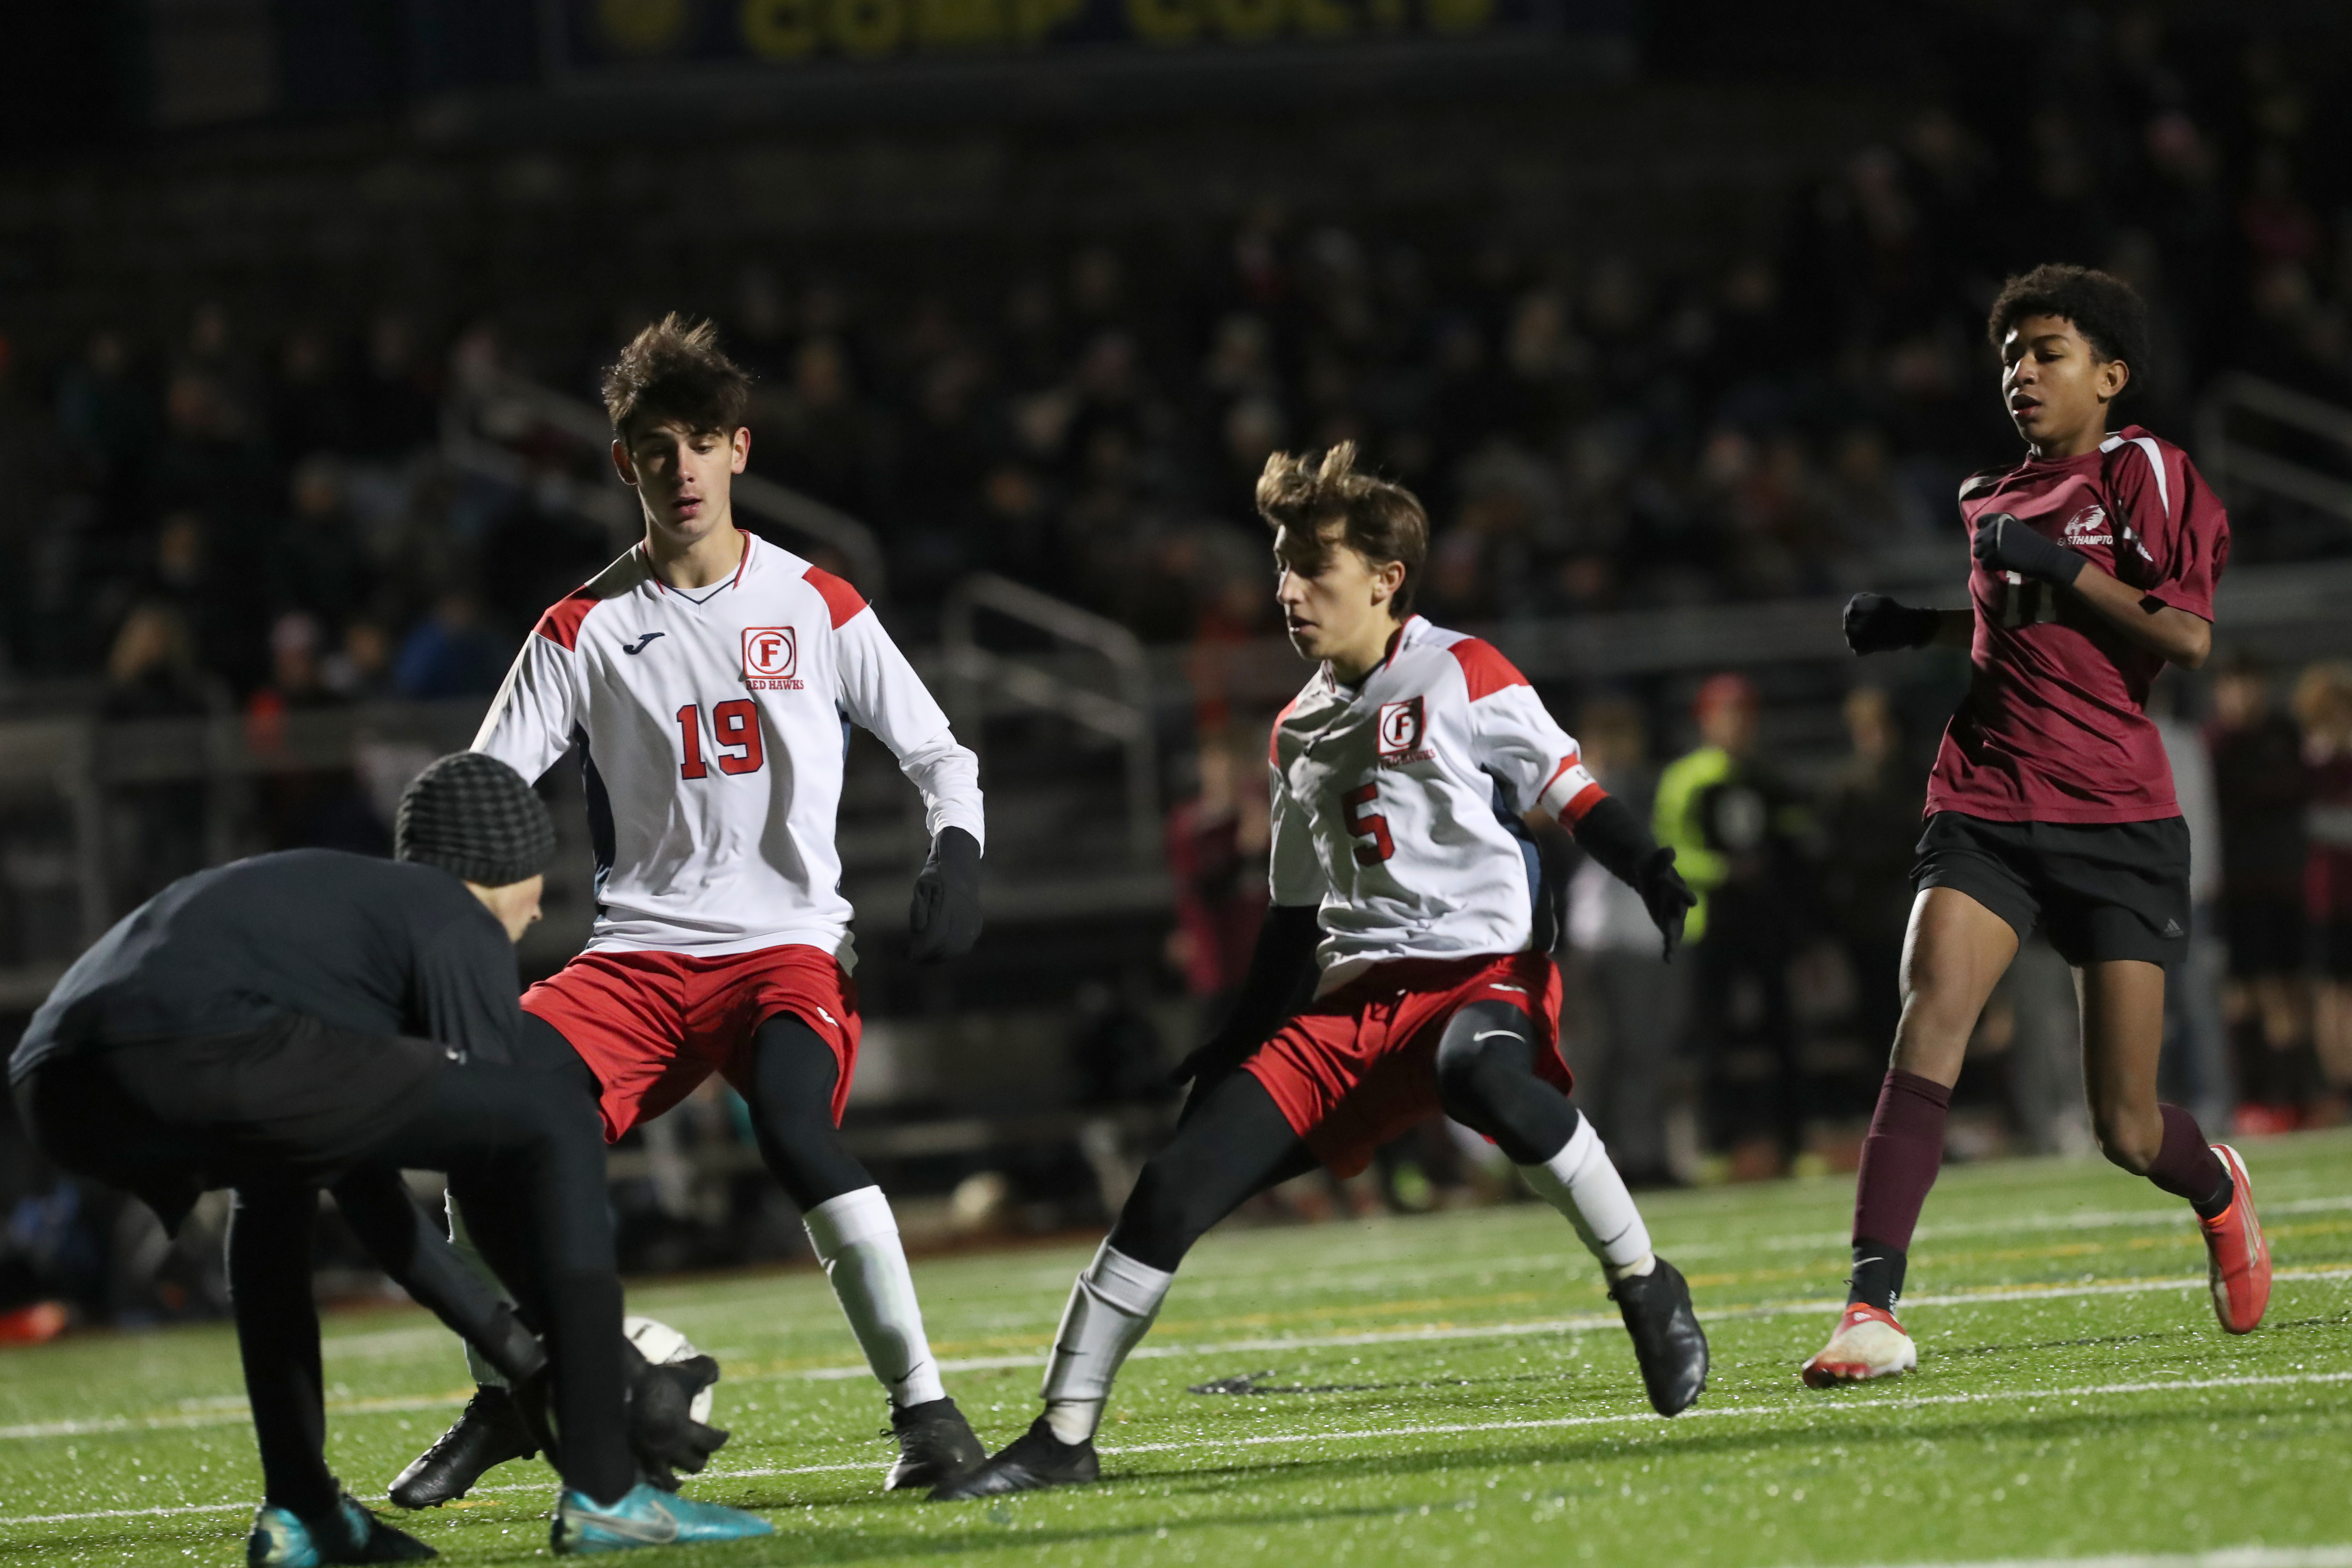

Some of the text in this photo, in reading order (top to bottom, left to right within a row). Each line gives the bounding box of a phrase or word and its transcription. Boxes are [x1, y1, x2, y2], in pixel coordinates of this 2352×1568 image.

[2057, 535, 2114, 547] ESTHAMPTO
[760, 640, 780, 667] F
[746, 680, 804, 690] RED HAWKS
[677, 698, 763, 780] 19
[1394, 713, 1411, 740] F
[1341, 781, 1395, 866] 5
